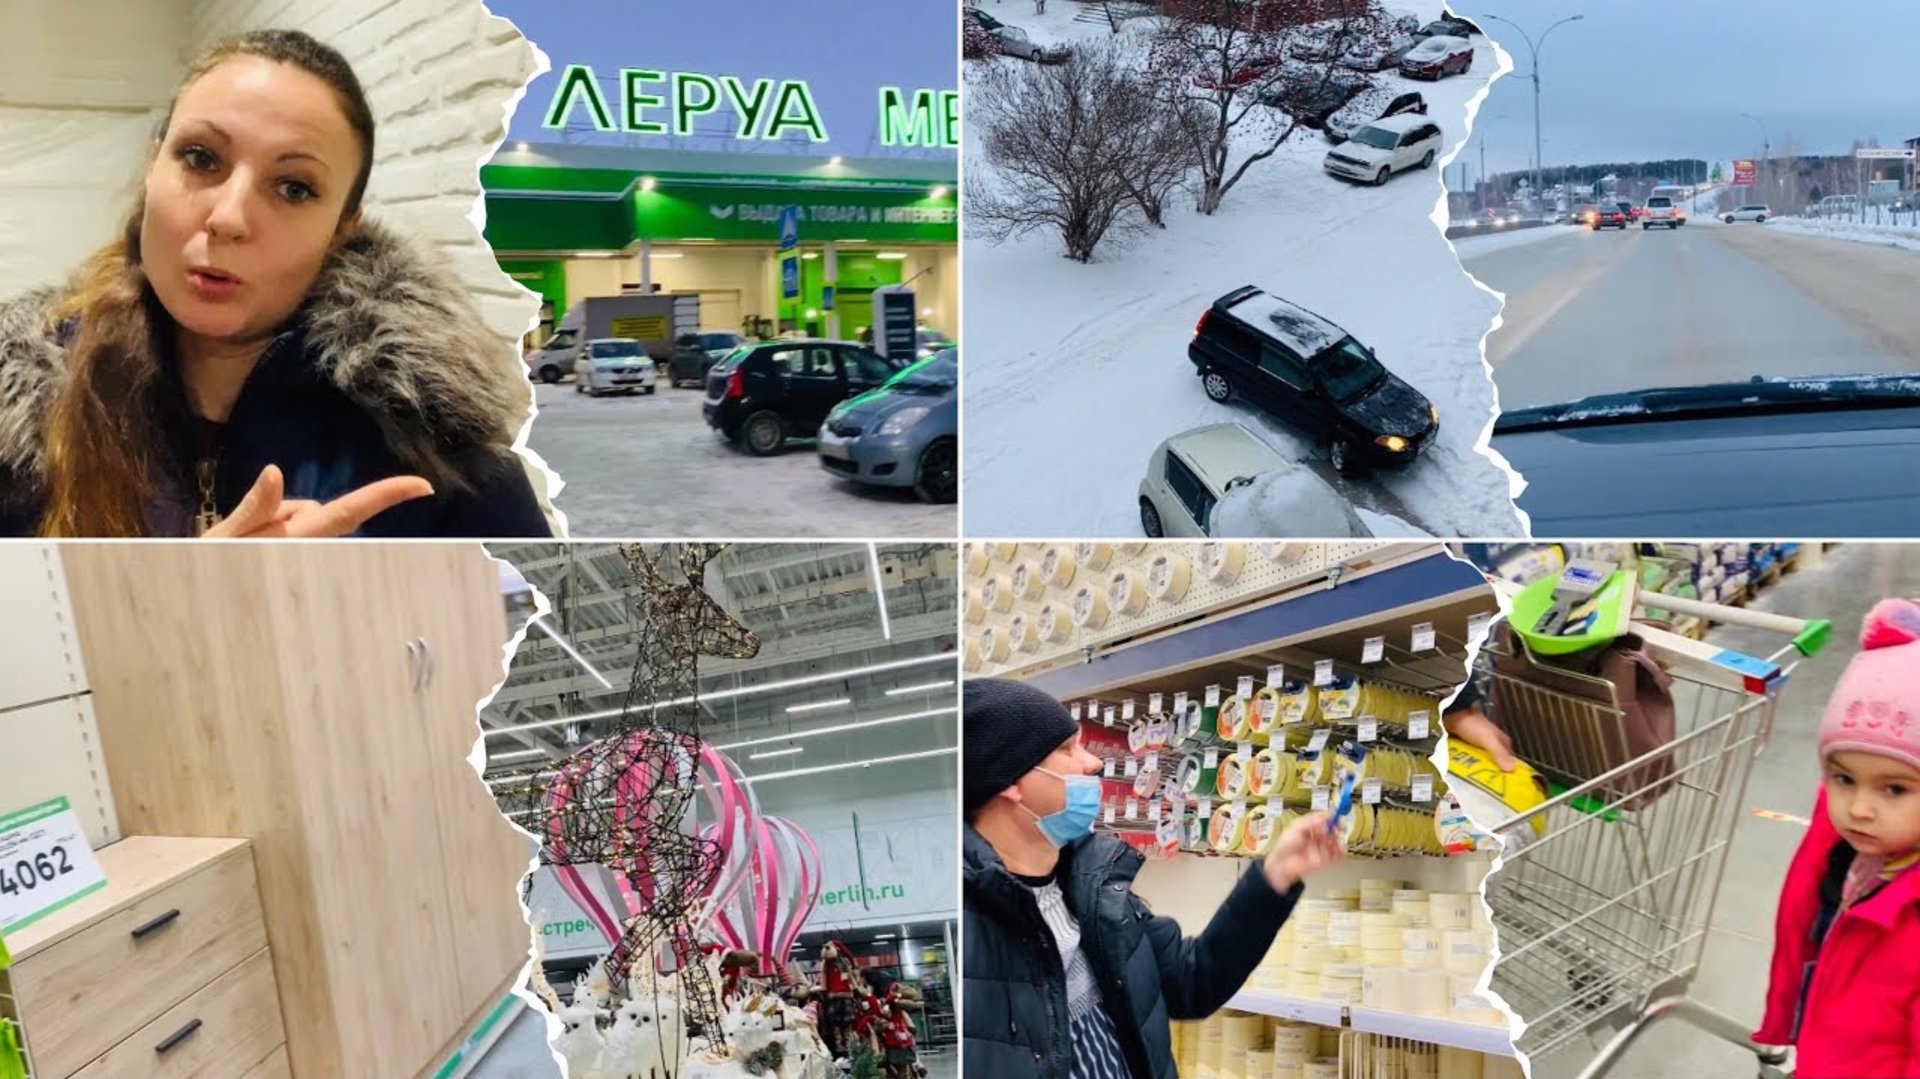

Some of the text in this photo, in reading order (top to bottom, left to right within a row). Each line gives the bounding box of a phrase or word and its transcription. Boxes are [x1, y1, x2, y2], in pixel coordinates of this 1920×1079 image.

[541, 64, 958, 149] ЛЕРУА МЕ
[808, 204, 868, 223] ТОВАРА
[870, 206, 881, 223] И
[0, 846, 75, 896] 4062
